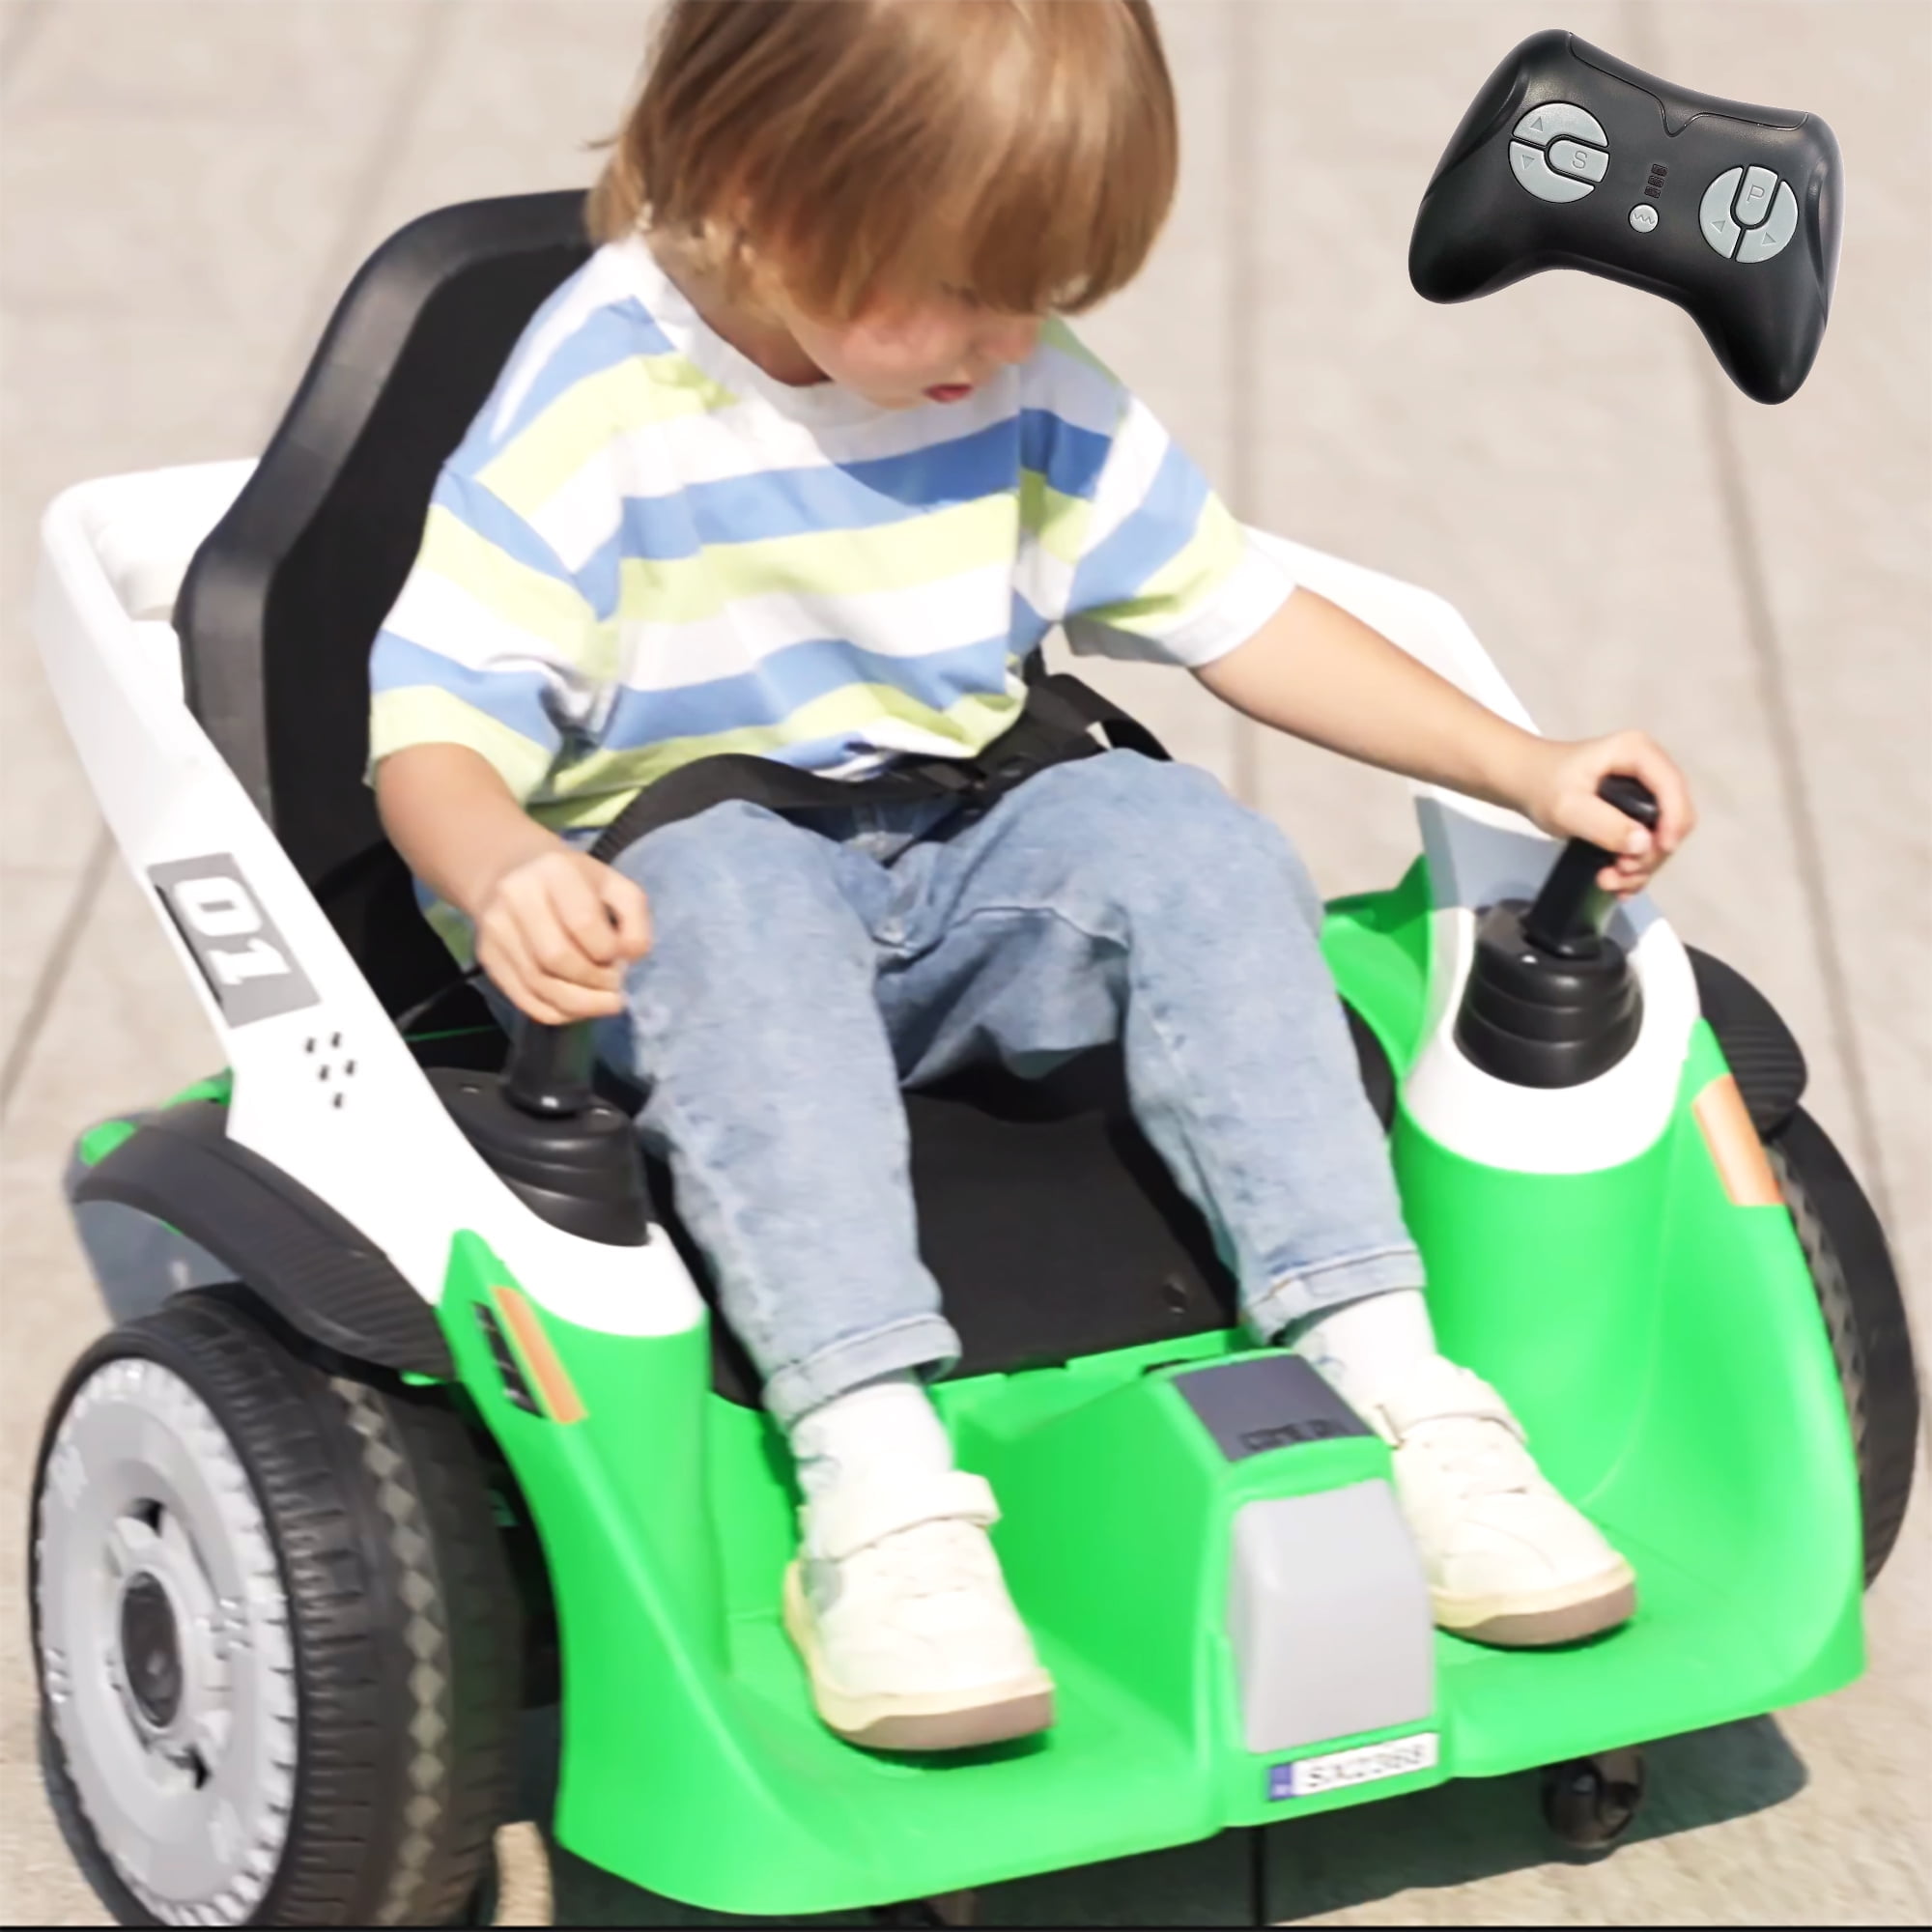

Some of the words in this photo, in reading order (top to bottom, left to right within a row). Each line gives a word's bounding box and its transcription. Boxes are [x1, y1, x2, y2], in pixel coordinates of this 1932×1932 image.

[1572, 150, 1588, 169] S
[1746, 184, 1766, 203] P
[173, 876, 291, 985] 01
